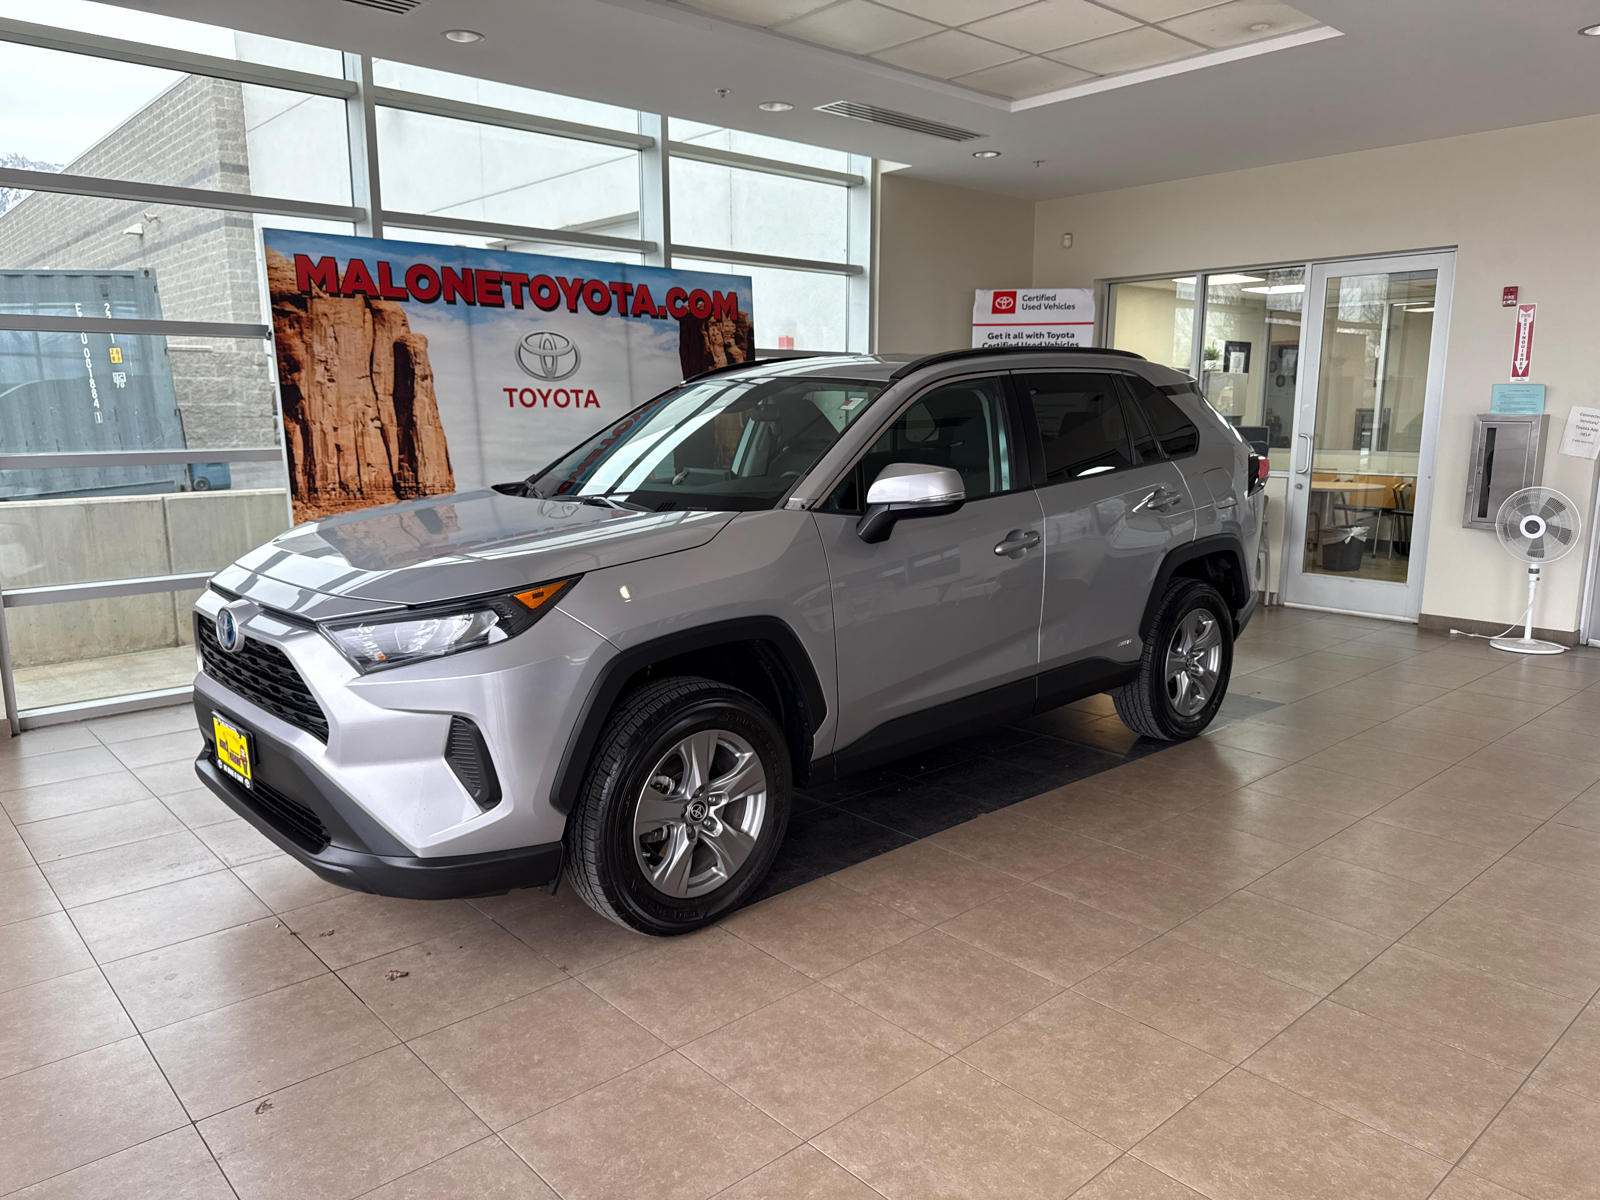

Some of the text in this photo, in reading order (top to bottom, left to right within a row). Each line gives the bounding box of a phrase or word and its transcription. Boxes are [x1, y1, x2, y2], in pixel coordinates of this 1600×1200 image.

[294, 254, 738, 321] MALONETOYOTA.COM
[1022, 294, 1056, 302] Certified
[1044, 302, 1076, 310] Vehicles
[987, 331, 1075, 341] Get it all with Toyota
[1519, 318, 1528, 370] EXTINGUISHER
[503, 388, 600, 409] TOYOTA
